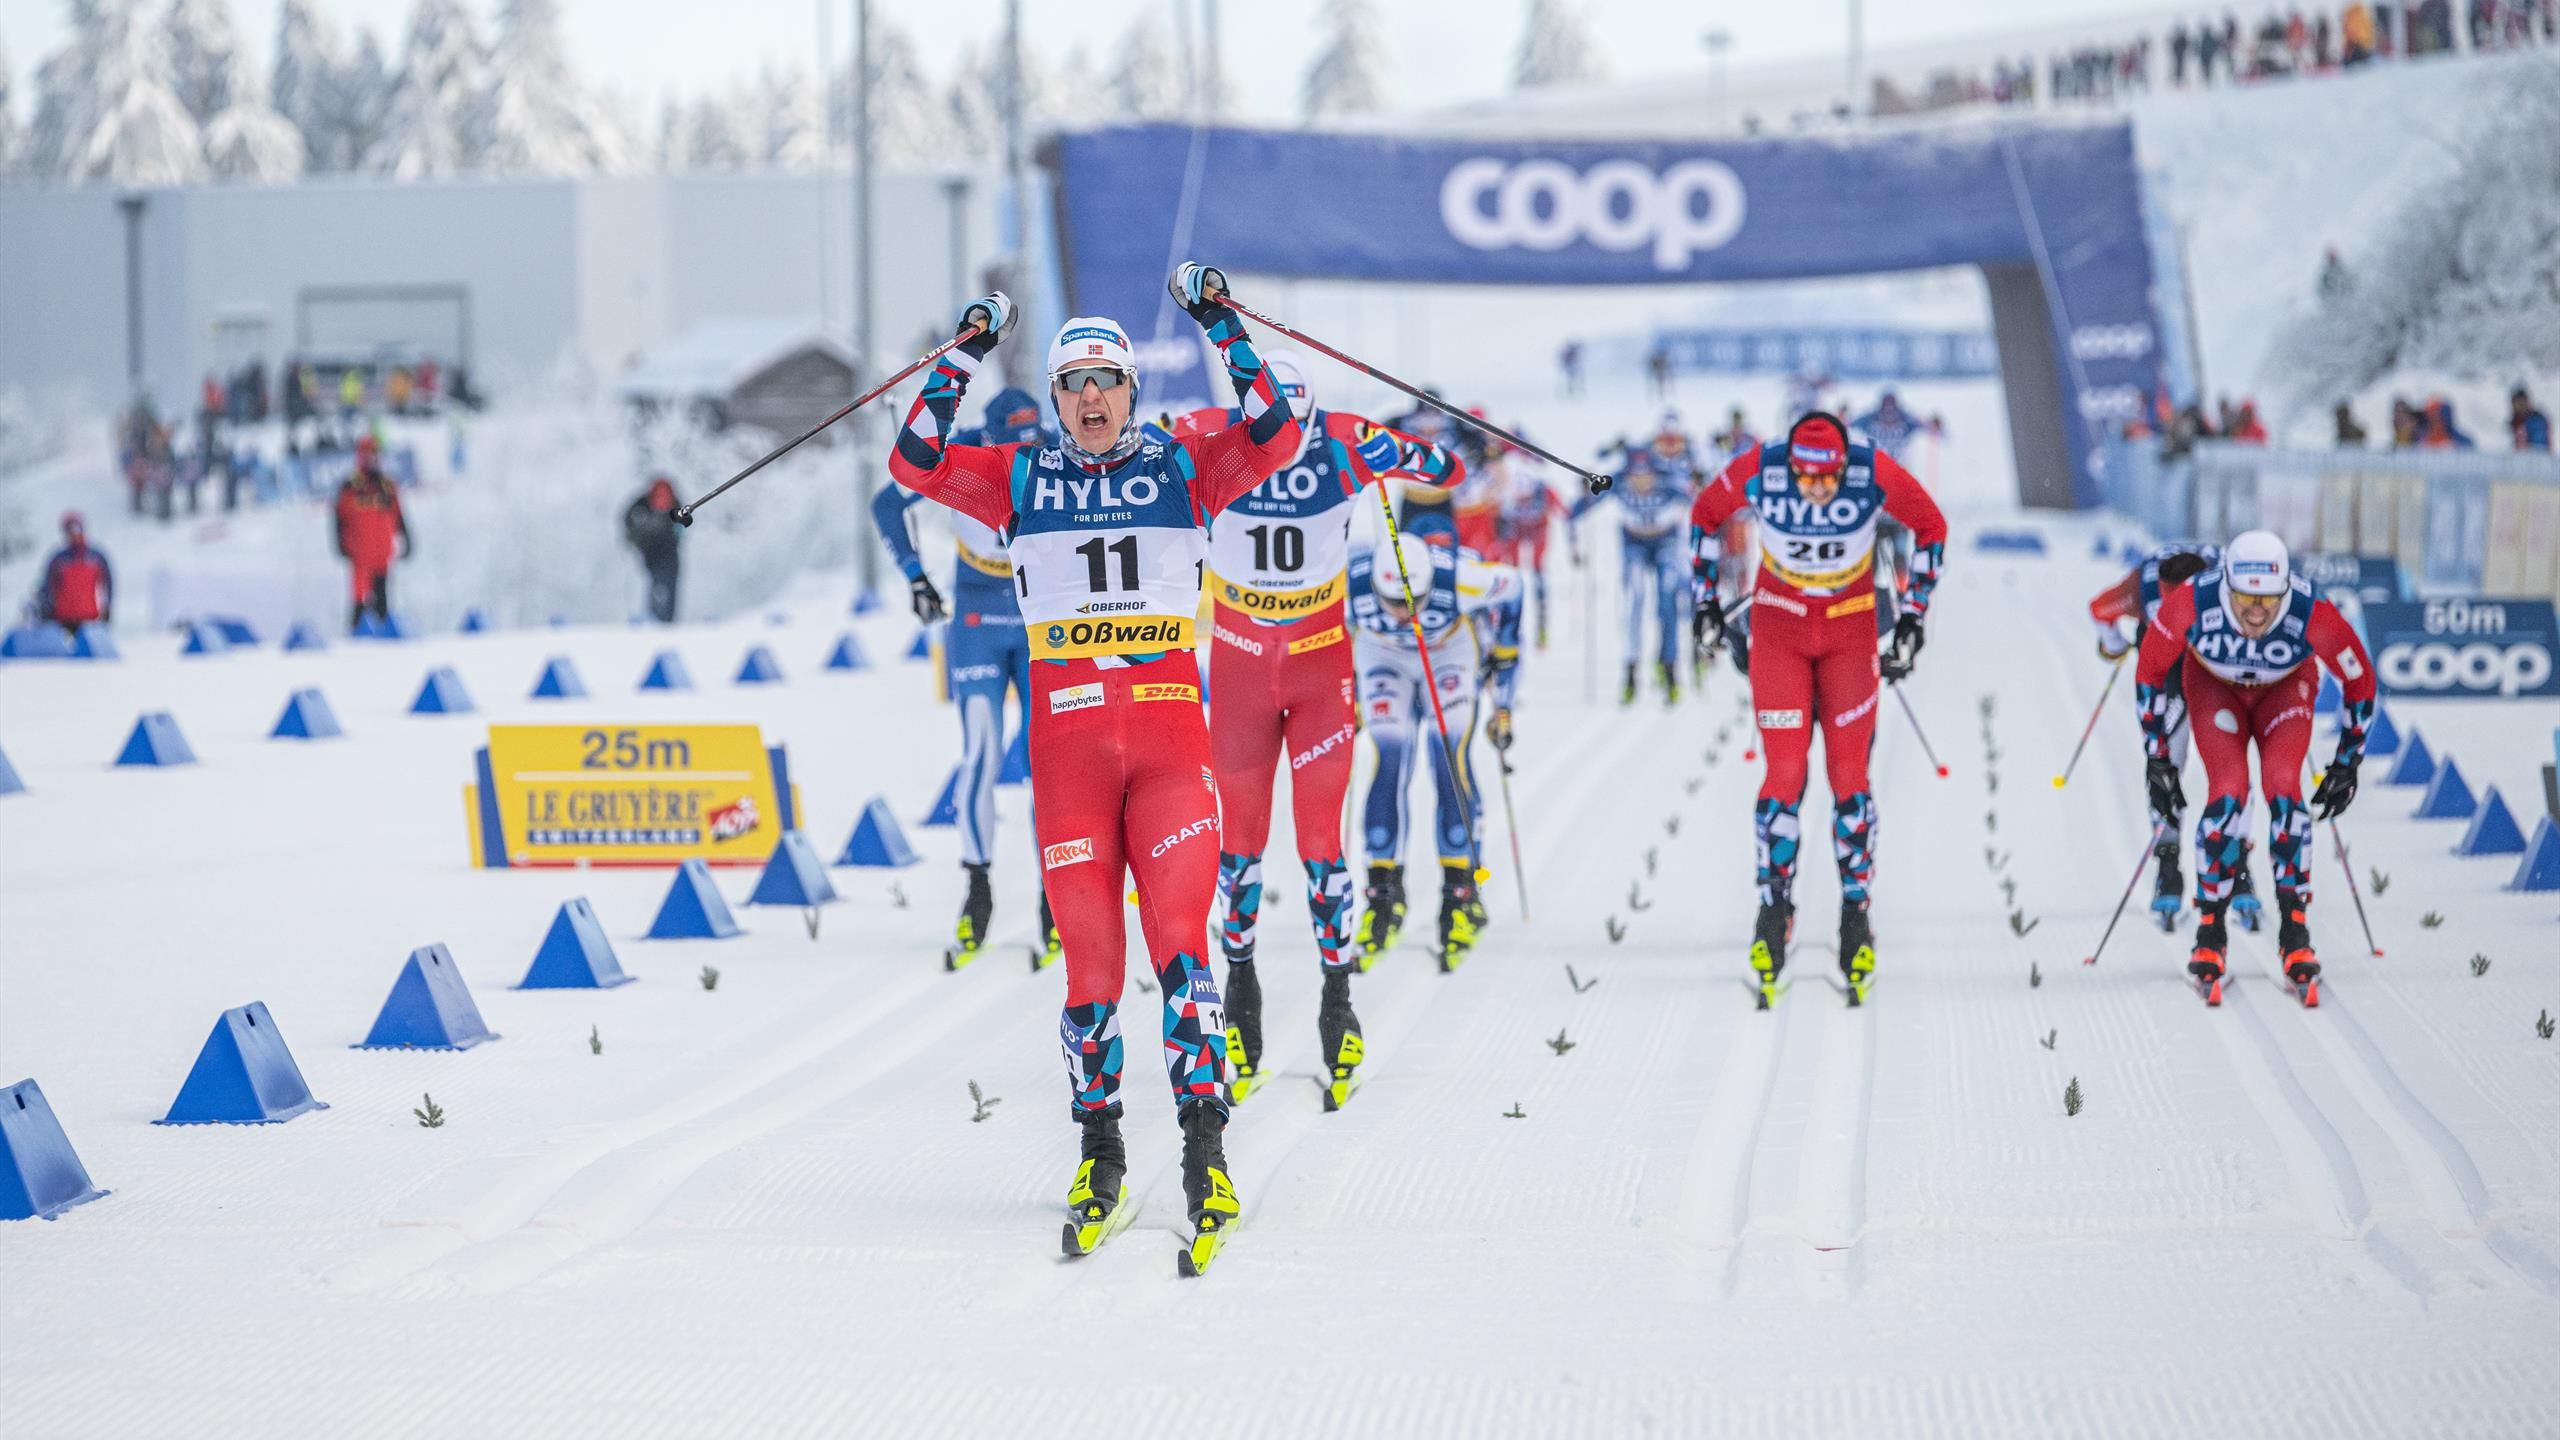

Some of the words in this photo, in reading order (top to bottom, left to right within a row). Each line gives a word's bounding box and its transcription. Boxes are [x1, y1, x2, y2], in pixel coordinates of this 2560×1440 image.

[1440, 156, 1747, 271] coop
[1062, 329, 1116, 343] SpareBank
[1034, 475, 1159, 510] HYLO
[1074, 514, 1090, 522] FOR
[1093, 513, 1108, 522] DRY
[1112, 511, 1132, 521] EYES
[1762, 496, 1859, 526] HYLO
[1075, 535, 1140, 592] 11
[1245, 525, 1304, 572] 10
[1786, 541, 1845, 562] 26
[1091, 601, 1147, 612] OBERHOF
[1243, 583, 1334, 610] Oßwald
[1070, 621, 1181, 645] Oßwald
[2197, 633, 2293, 665] HYLO
[2378, 642, 2552, 697] coop
[1052, 695, 1103, 711] happybytes
[1143, 686, 1193, 698] DHL
[582, 731, 691, 769] 25m
[1292, 730, 1345, 770] CRAFT
[527, 792, 560, 822] LE
[568, 783, 700, 823] GRUYÈRE
[530, 830, 696, 844] SWITZERLAND
[1151, 818, 1213, 858] CRAFT
[1209, 1009, 1226, 1033] 11
